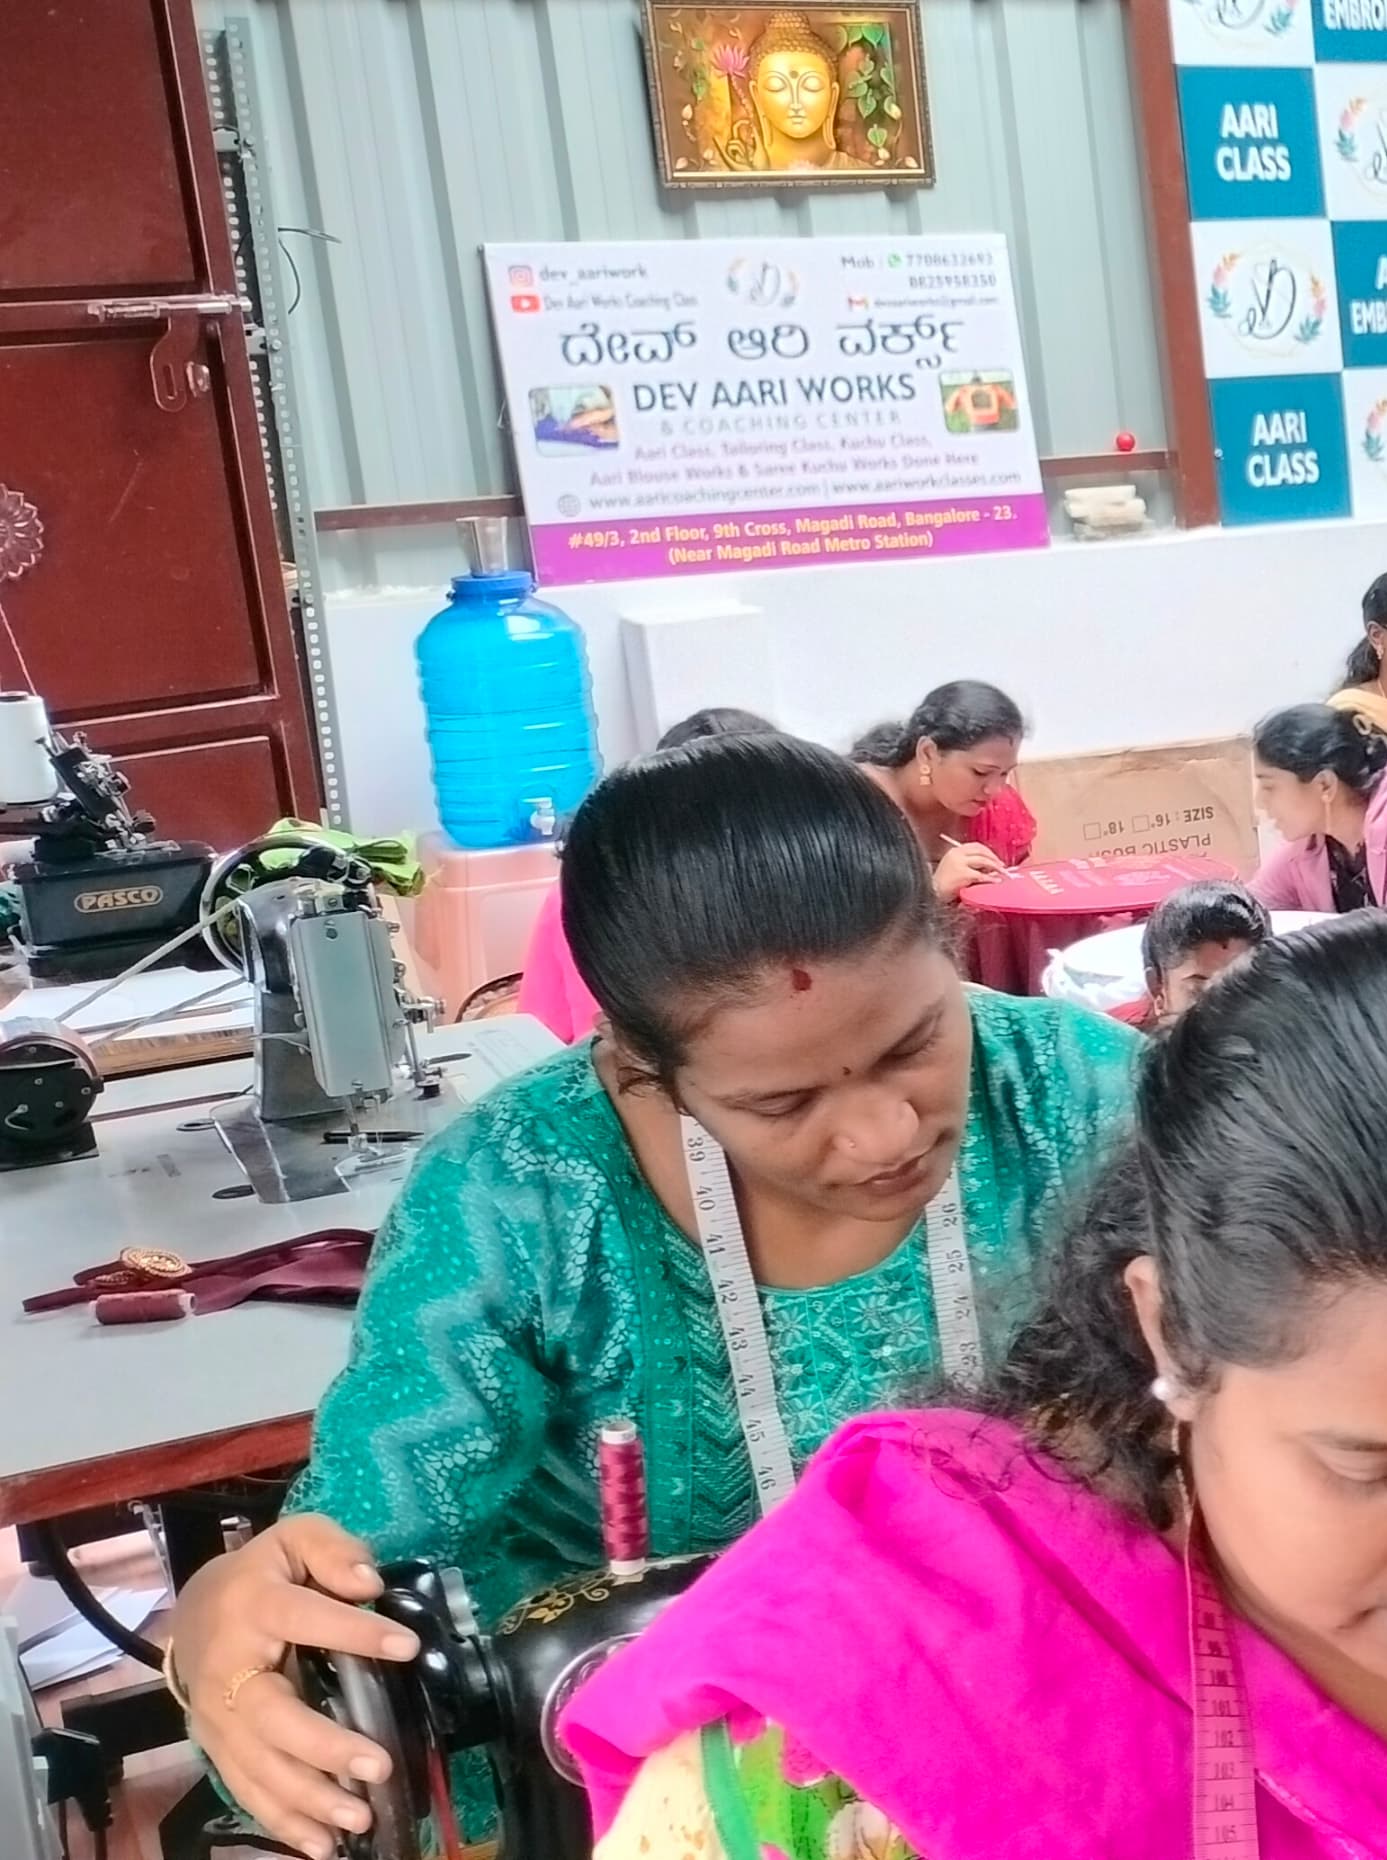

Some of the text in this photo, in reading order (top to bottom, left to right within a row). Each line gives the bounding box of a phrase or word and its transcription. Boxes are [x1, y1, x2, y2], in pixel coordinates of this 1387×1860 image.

[1222, 105, 1278, 138] AARI
[1216, 146, 1290, 180] CLASS
[842, 256, 874, 269] Mob
[728, 322, 810, 360] ಆರಿ
[633, 372, 916, 413] DEV AARI WORKS
[681, 413, 808, 434] COACHING
[816, 409, 900, 430] CENTER
[1253, 412, 1306, 446] AARI
[635, 446, 666, 461] Aari
[722, 439, 787, 457] Tailoring
[590, 470, 623, 487] Aari
[628, 468, 679, 483] Blouse
[685, 466, 733, 481] Works
[755, 461, 795, 475] Saree
[853, 455, 899, 471] Works
[902, 453, 941, 469] Done
[945, 452, 979, 466] Here
[1247, 451, 1319, 487] CLASS
[568, 531, 627, 550] #49/3,
[630, 527, 661, 546] 2nd
[665, 524, 709, 542] Floor,
[713, 522, 740, 539] 9th
[744, 521, 791, 538] Cross,
[796, 514, 854, 536] Magadi
[858, 513, 902, 531] Road,
[906, 507, 981, 529] Bangalore
[669, 530, 934, 566] (Near Magadi Road Metro Station)
[1184, 806, 1214, 823] SIZE
[1142, 833, 1211, 855] PLASTIC
[81, 888, 158, 910] PASCO
[696, 1185, 716, 1211] 40
[706, 1233, 726, 1254] 41
[718, 1279, 738, 1304] 42
[729, 1327, 748, 1351] 43
[738, 1374, 756, 1397] 44
[746, 1419, 765, 1442] 45
[758, 1466, 777, 1491] 46
